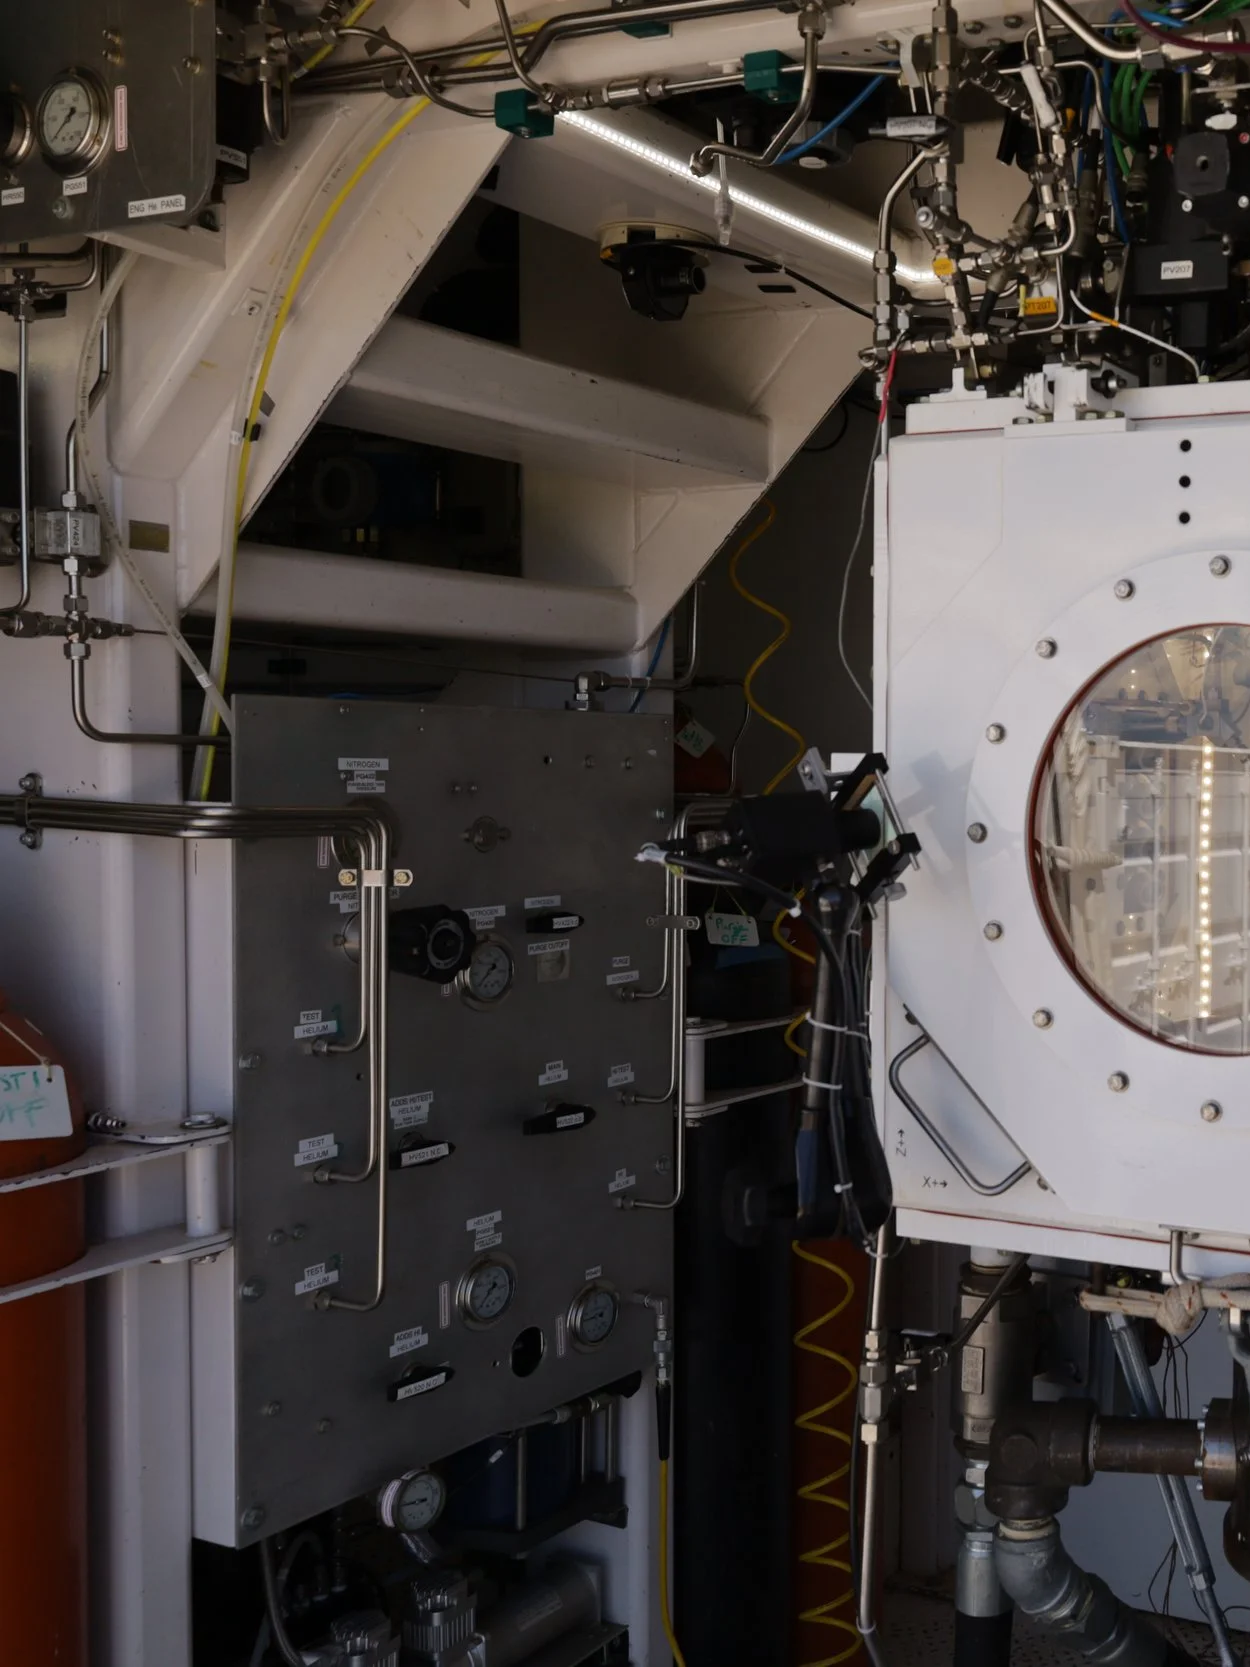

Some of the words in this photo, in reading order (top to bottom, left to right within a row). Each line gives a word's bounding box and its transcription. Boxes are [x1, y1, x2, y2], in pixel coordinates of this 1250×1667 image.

[129, 203, 145, 215] ENG
[160, 197, 184, 210] PANEL
[1163, 265, 1191, 274] PV207
[72, 519, 80, 546] PV424
[346, 760, 381, 768] NITROGEN
[333, 891, 357, 900] PURGE
[469, 908, 499, 918] NITROGEN
[529, 943, 547, 952] PURGE
[548, 940, 569, 950] CUTOFF
[302, 1012, 320, 1021] TEST
[302, 1024, 329, 1034] HELIUM
[398, 1105, 421, 1115] HELIUM
[308, 1138, 325, 1148] TEST
[302, 1150, 329, 1161] HELIUM
[473, 1215, 495, 1226] HELIUM
[306, 1266, 324, 1276] TEST
[303, 1276, 330, 1289] HELIUM
[397, 1338, 421, 1352] HELIUM
